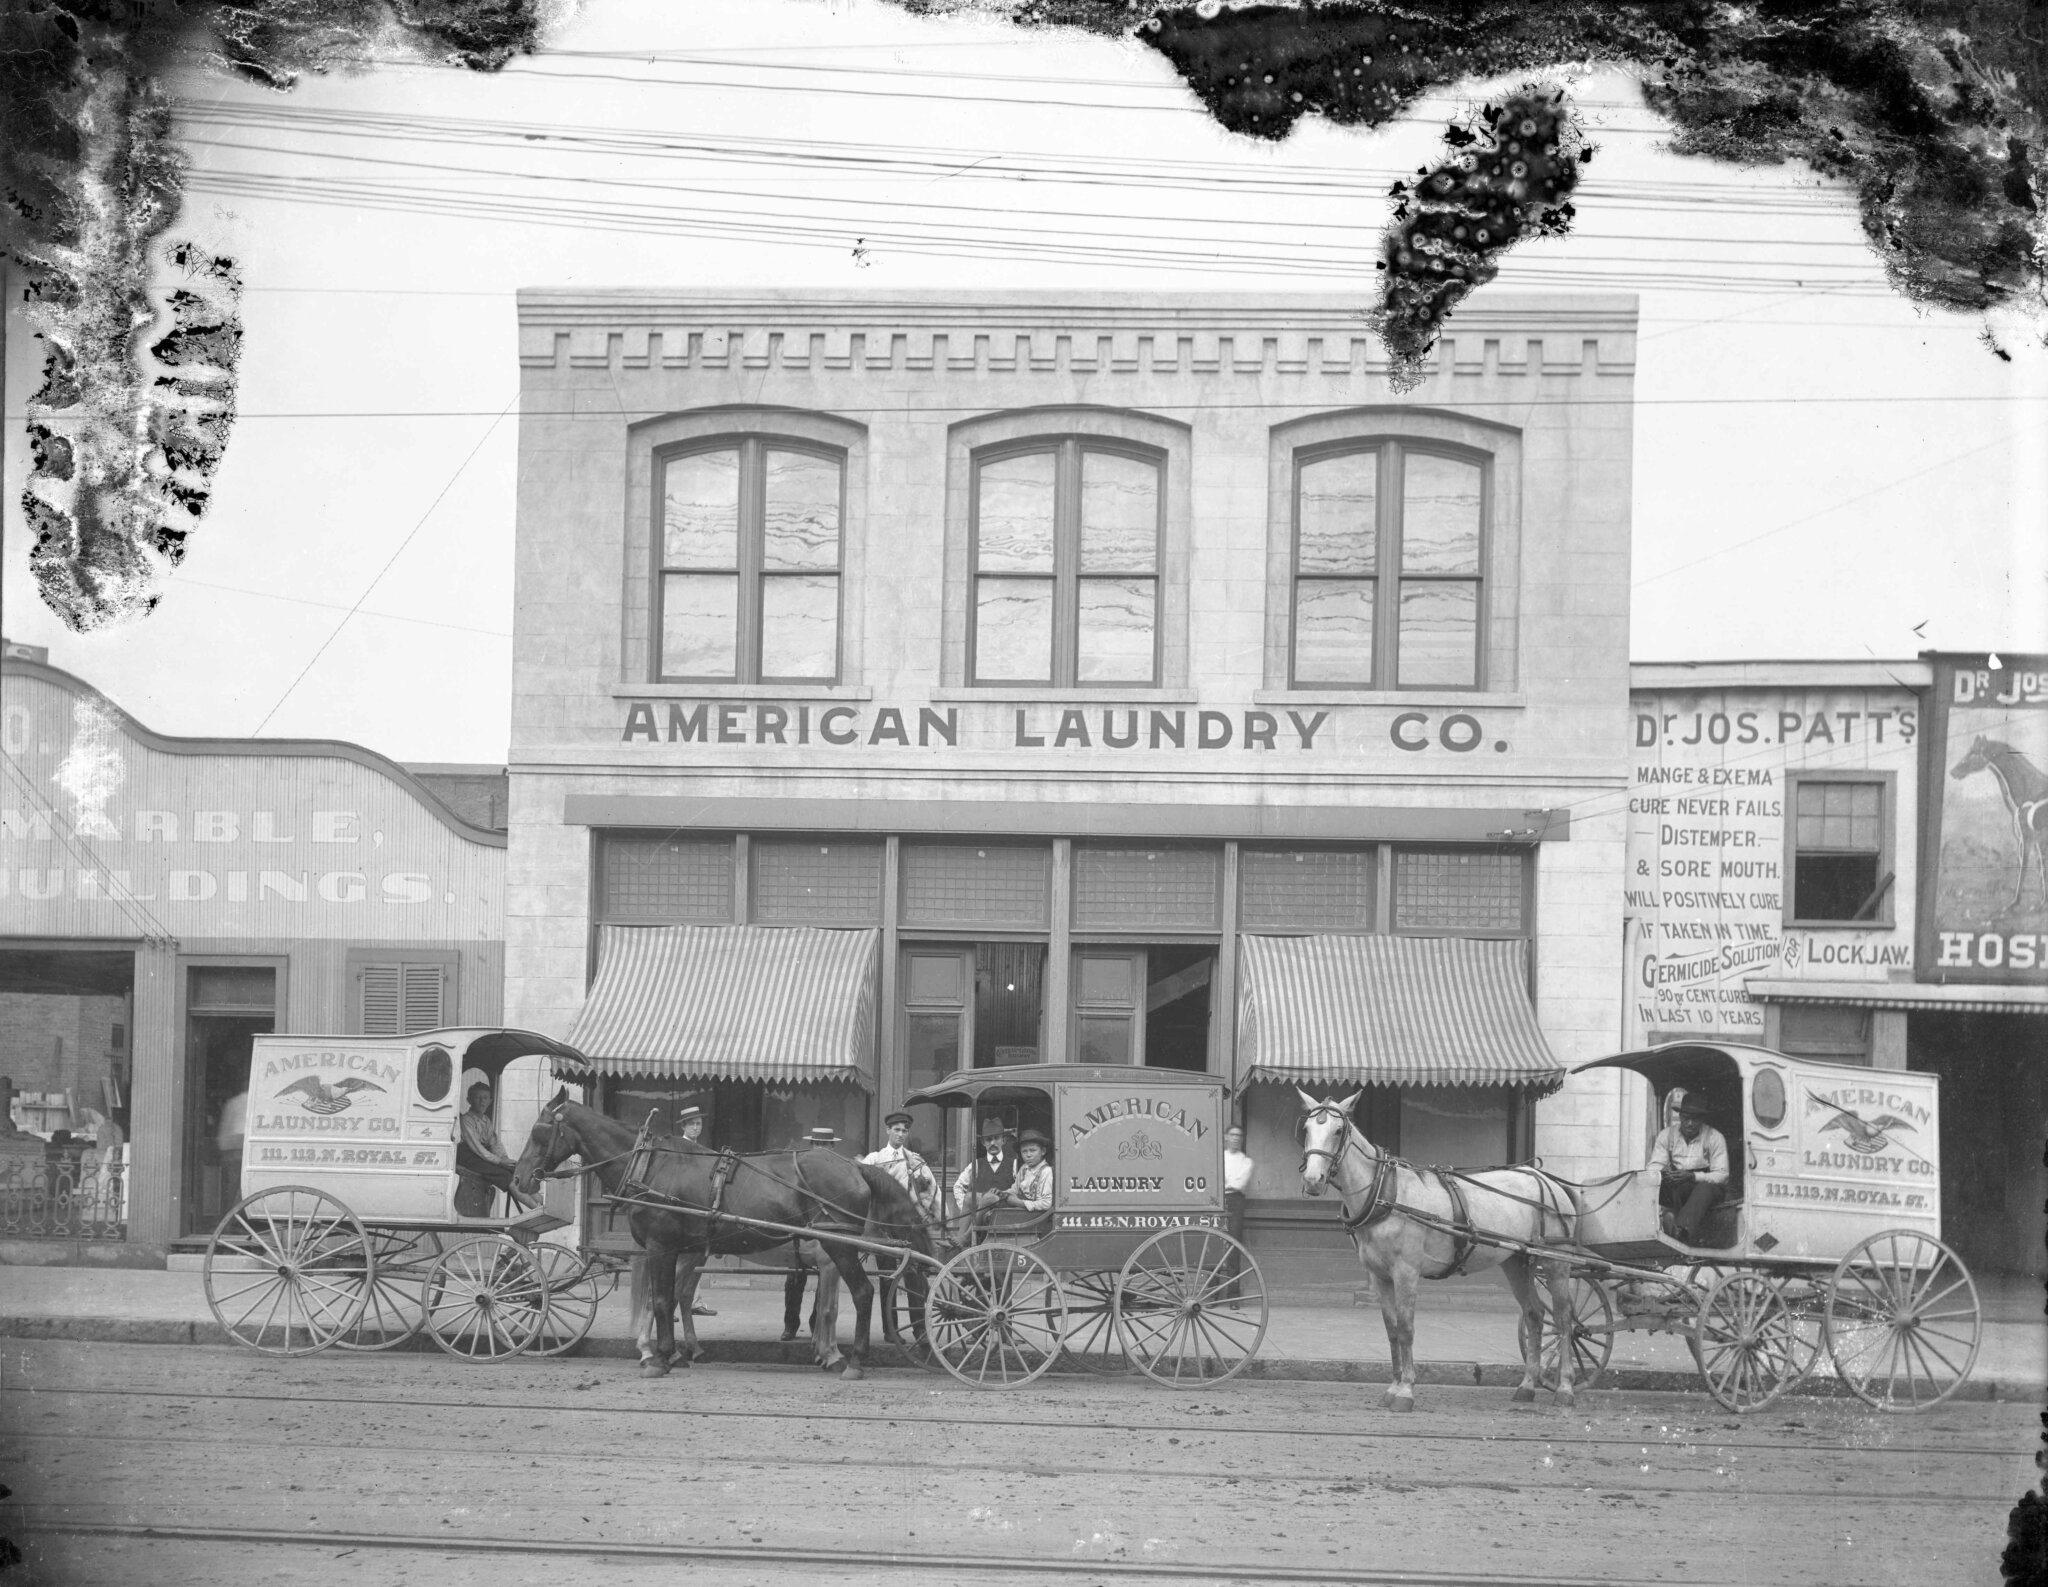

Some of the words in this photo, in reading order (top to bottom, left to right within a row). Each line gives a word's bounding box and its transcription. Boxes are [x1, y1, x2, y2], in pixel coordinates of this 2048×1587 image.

[621, 703, 958, 747] AMERICAN
[1015, 709, 1329, 750] LAUNDRY
[1390, 712, 1509, 752] CO.
[1637, 766, 1693, 784] MANGE
[1697, 768, 1709, 784] &
[1713, 768, 1773, 786] EXEMA
[1629, 798, 1671, 815] CURE
[1677, 799, 1729, 816] NEVER
[1736, 800, 1784, 818] FAILS.
[1636, 859, 1650, 876] &
[1660, 860, 1711, 878] SORE
[1721, 861, 1781, 879] MOUTH.
[0, 868, 456, 905] UILDINGS.
[1624, 890, 1660, 908] WILL
[1662, 891, 1746, 910] POSITIVELY
[1750, 892, 1783, 911] CURE
[1640, 922, 1654, 939] IF
[1660, 923, 1712, 940] TAKEN
[1714, 923, 1732, 940] IN
[1734, 924, 1779, 941] TIME.
[1784, 937, 1800, 968] FOR
[1808, 938, 1911, 966] LOCKJAW.
[1642, 953, 1719, 988] GERMICIDE
[1721, 943, 1780, 970] SOLUTION
[1658, 988, 1673, 1002] 90
[1686, 989, 1717, 1003] CENT
[1638, 1003, 1655, 1022] IN
[1657, 1009, 1692, 1023] LAST
[1697, 1009, 1713, 1023] 10
[1720, 1010, 1764, 1025] YEARS.
[265, 1052, 402, 1083] AMERICAN
[1803, 1089, 1931, 1125] AMERICAN
[256, 1114, 365, 1131] LAUNDRY
[1069, 1097, 1209, 1147] AMERICAN
[420, 1128, 432, 1137] 4
[1766, 1156, 1775, 1167] 3
[1803, 1150, 1904, 1172] LAUNDRY
[1908, 1159, 1934, 1175] CO.
[1070, 1177, 1164, 1192] LAUNDRY
[1184, 1176, 1207, 1192] CO
[1017, 1254, 1027, 1267] 5
